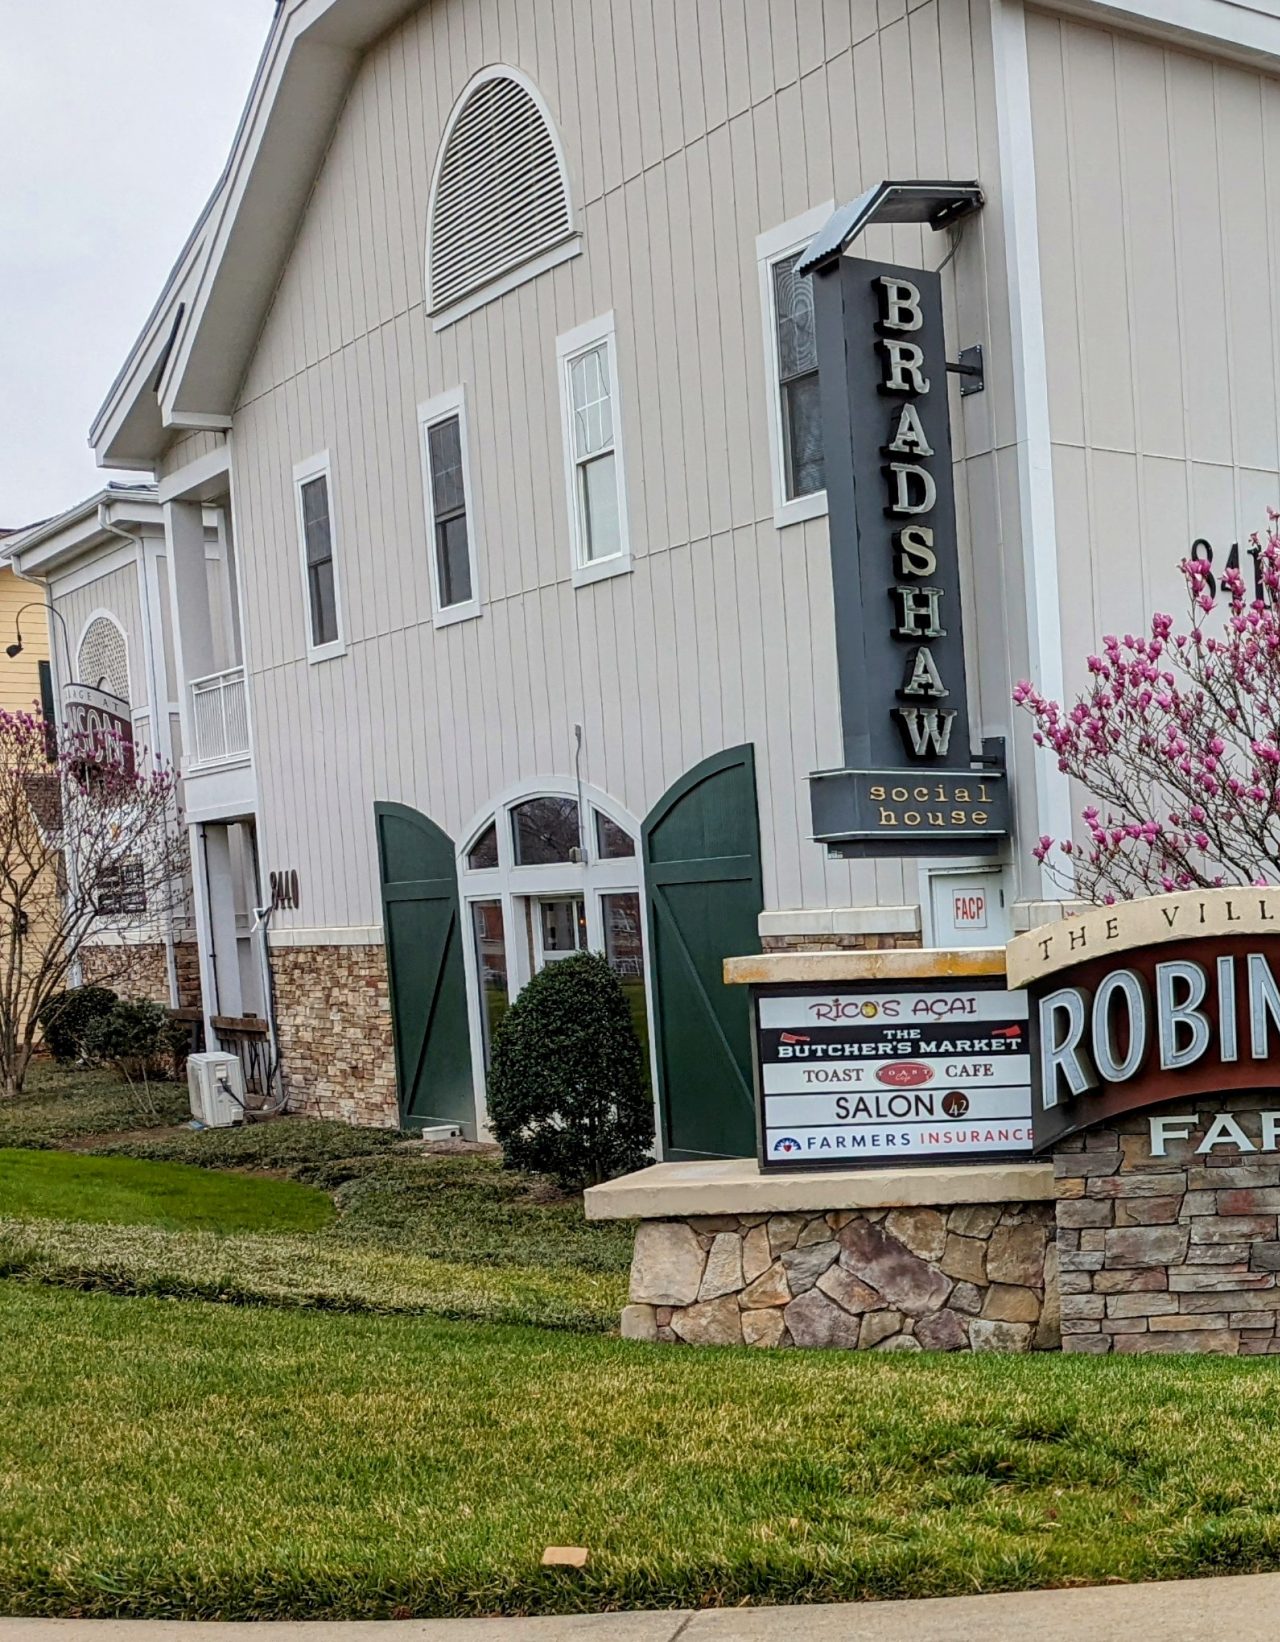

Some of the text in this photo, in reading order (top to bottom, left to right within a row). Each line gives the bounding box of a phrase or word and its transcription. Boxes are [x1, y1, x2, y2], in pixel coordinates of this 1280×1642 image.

[874, 274, 958, 757] BRADSHAW
[869, 784, 993, 803] social
[878, 807, 989, 826] house
[955, 896, 986, 920] FACP
[1037, 917, 1120, 961] THE
[911, 997, 977, 1021] AÇAI
[882, 1029, 922, 1040] THE
[777, 1037, 1022, 1059] BUTCHER'S MARKET
[802, 1063, 995, 1084] TOAST CAFE
[835, 1093, 967, 1120] SALON 42
[806, 1128, 1035, 1150] FARMERS INSURANCE
